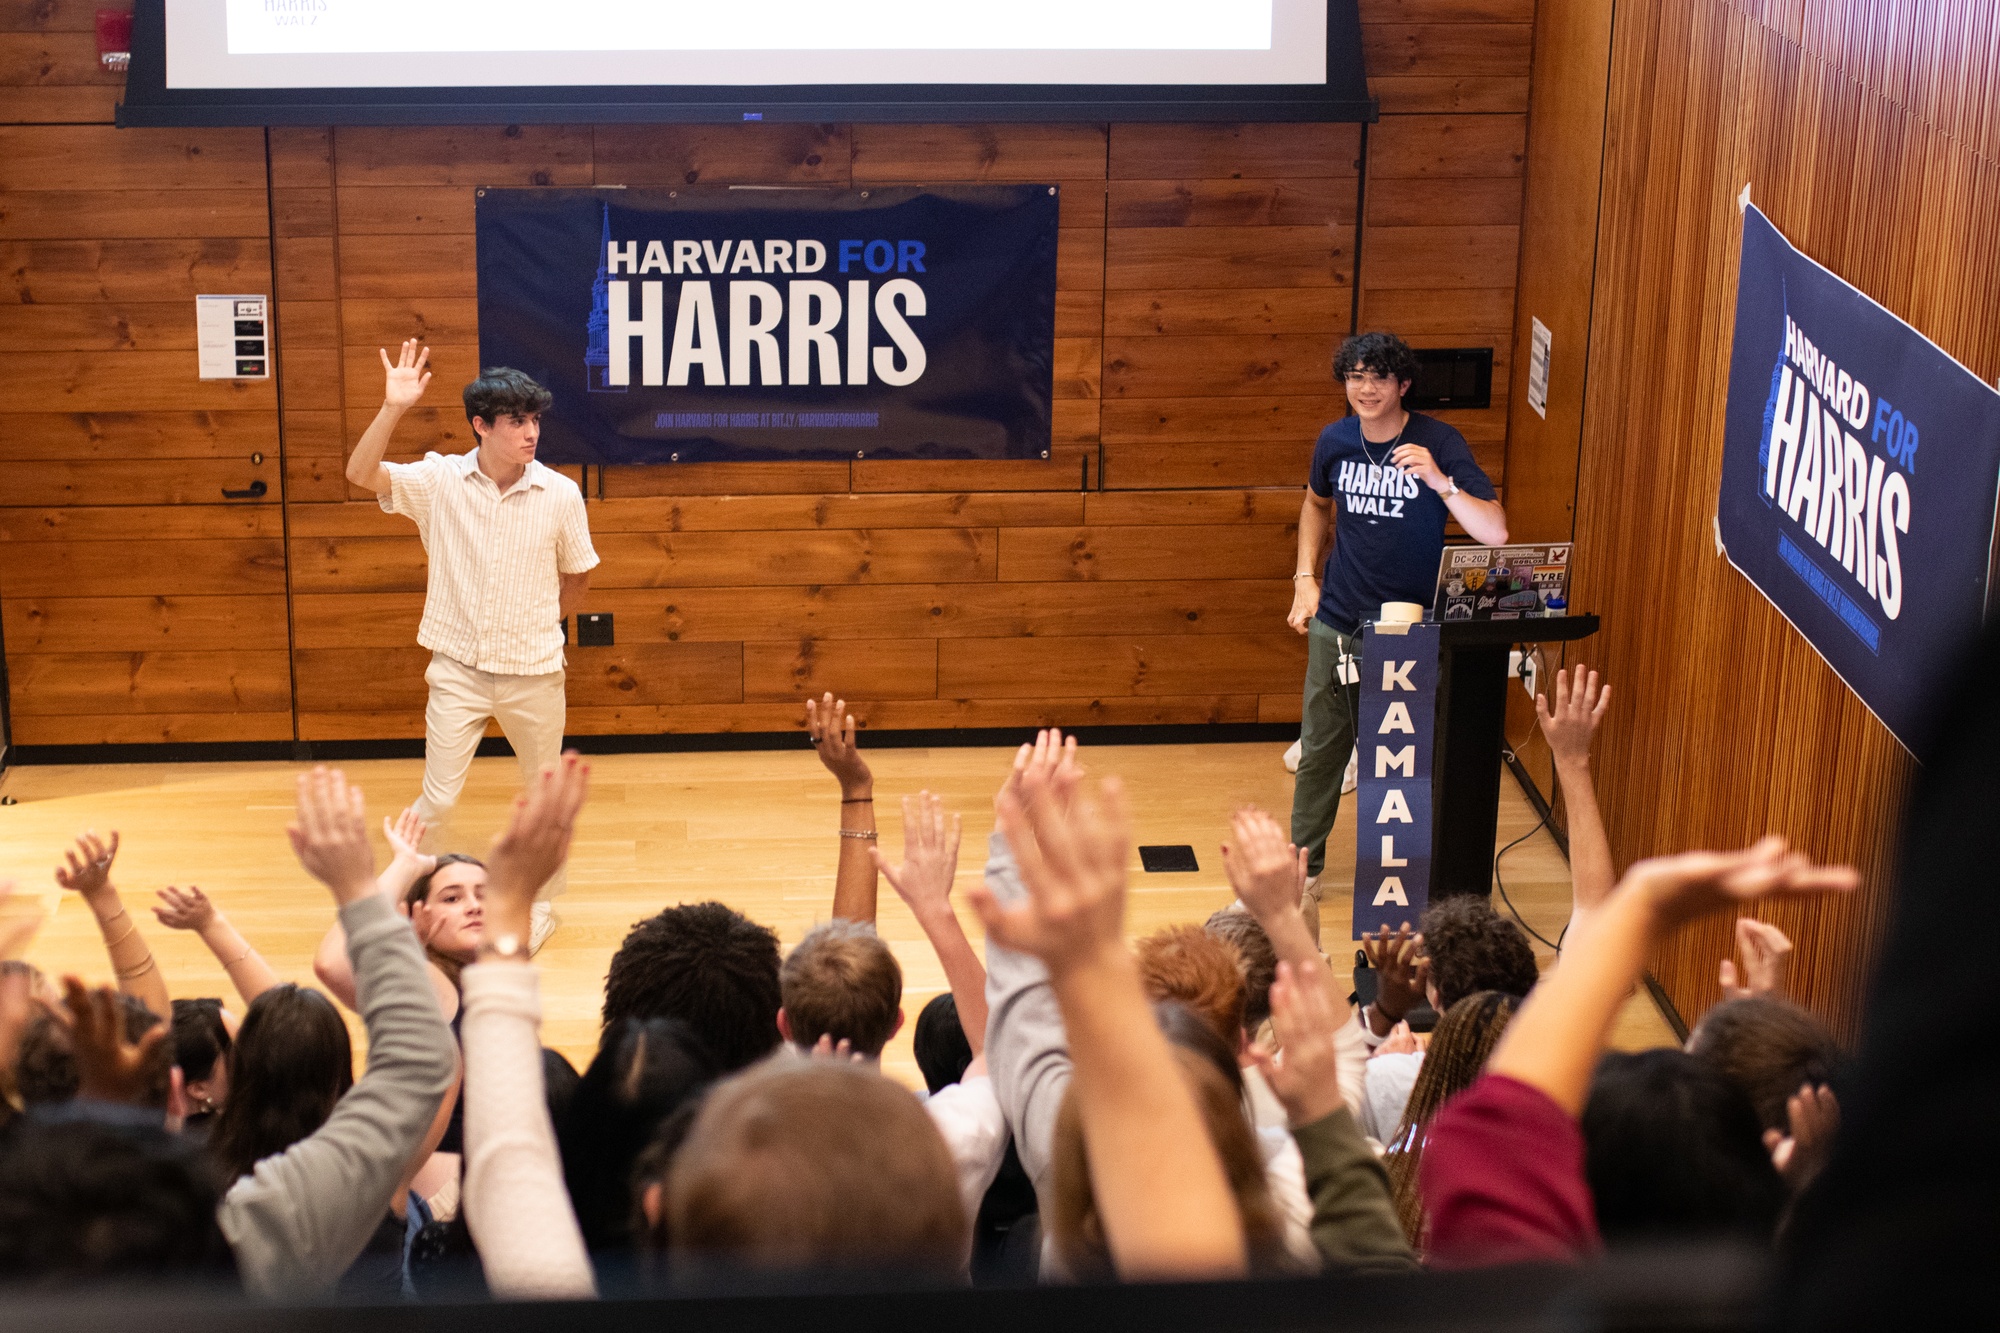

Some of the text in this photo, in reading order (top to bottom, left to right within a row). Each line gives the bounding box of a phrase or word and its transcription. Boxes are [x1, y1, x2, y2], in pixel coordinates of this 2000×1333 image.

[274, 15, 319, 26] WALZ
[607, 239, 927, 274] HARVARD FOR
[608, 278, 927, 386] HARRIS
[1785, 314, 1919, 475] HARVARD FOR
[655, 412, 674, 428] JOIN
[675, 412, 712, 428] HARVARD
[713, 412, 729, 428] FOR
[729, 412, 759, 428] HARRIS
[760, 412, 770, 428] AT
[1338, 460, 1419, 499] HARRIS
[1766, 363, 1910, 620] HARRIS
[1345, 493, 1404, 518] WALZ
[1532, 572, 1564, 581] FYRE
[1371, 660, 1417, 906] KAMALA
